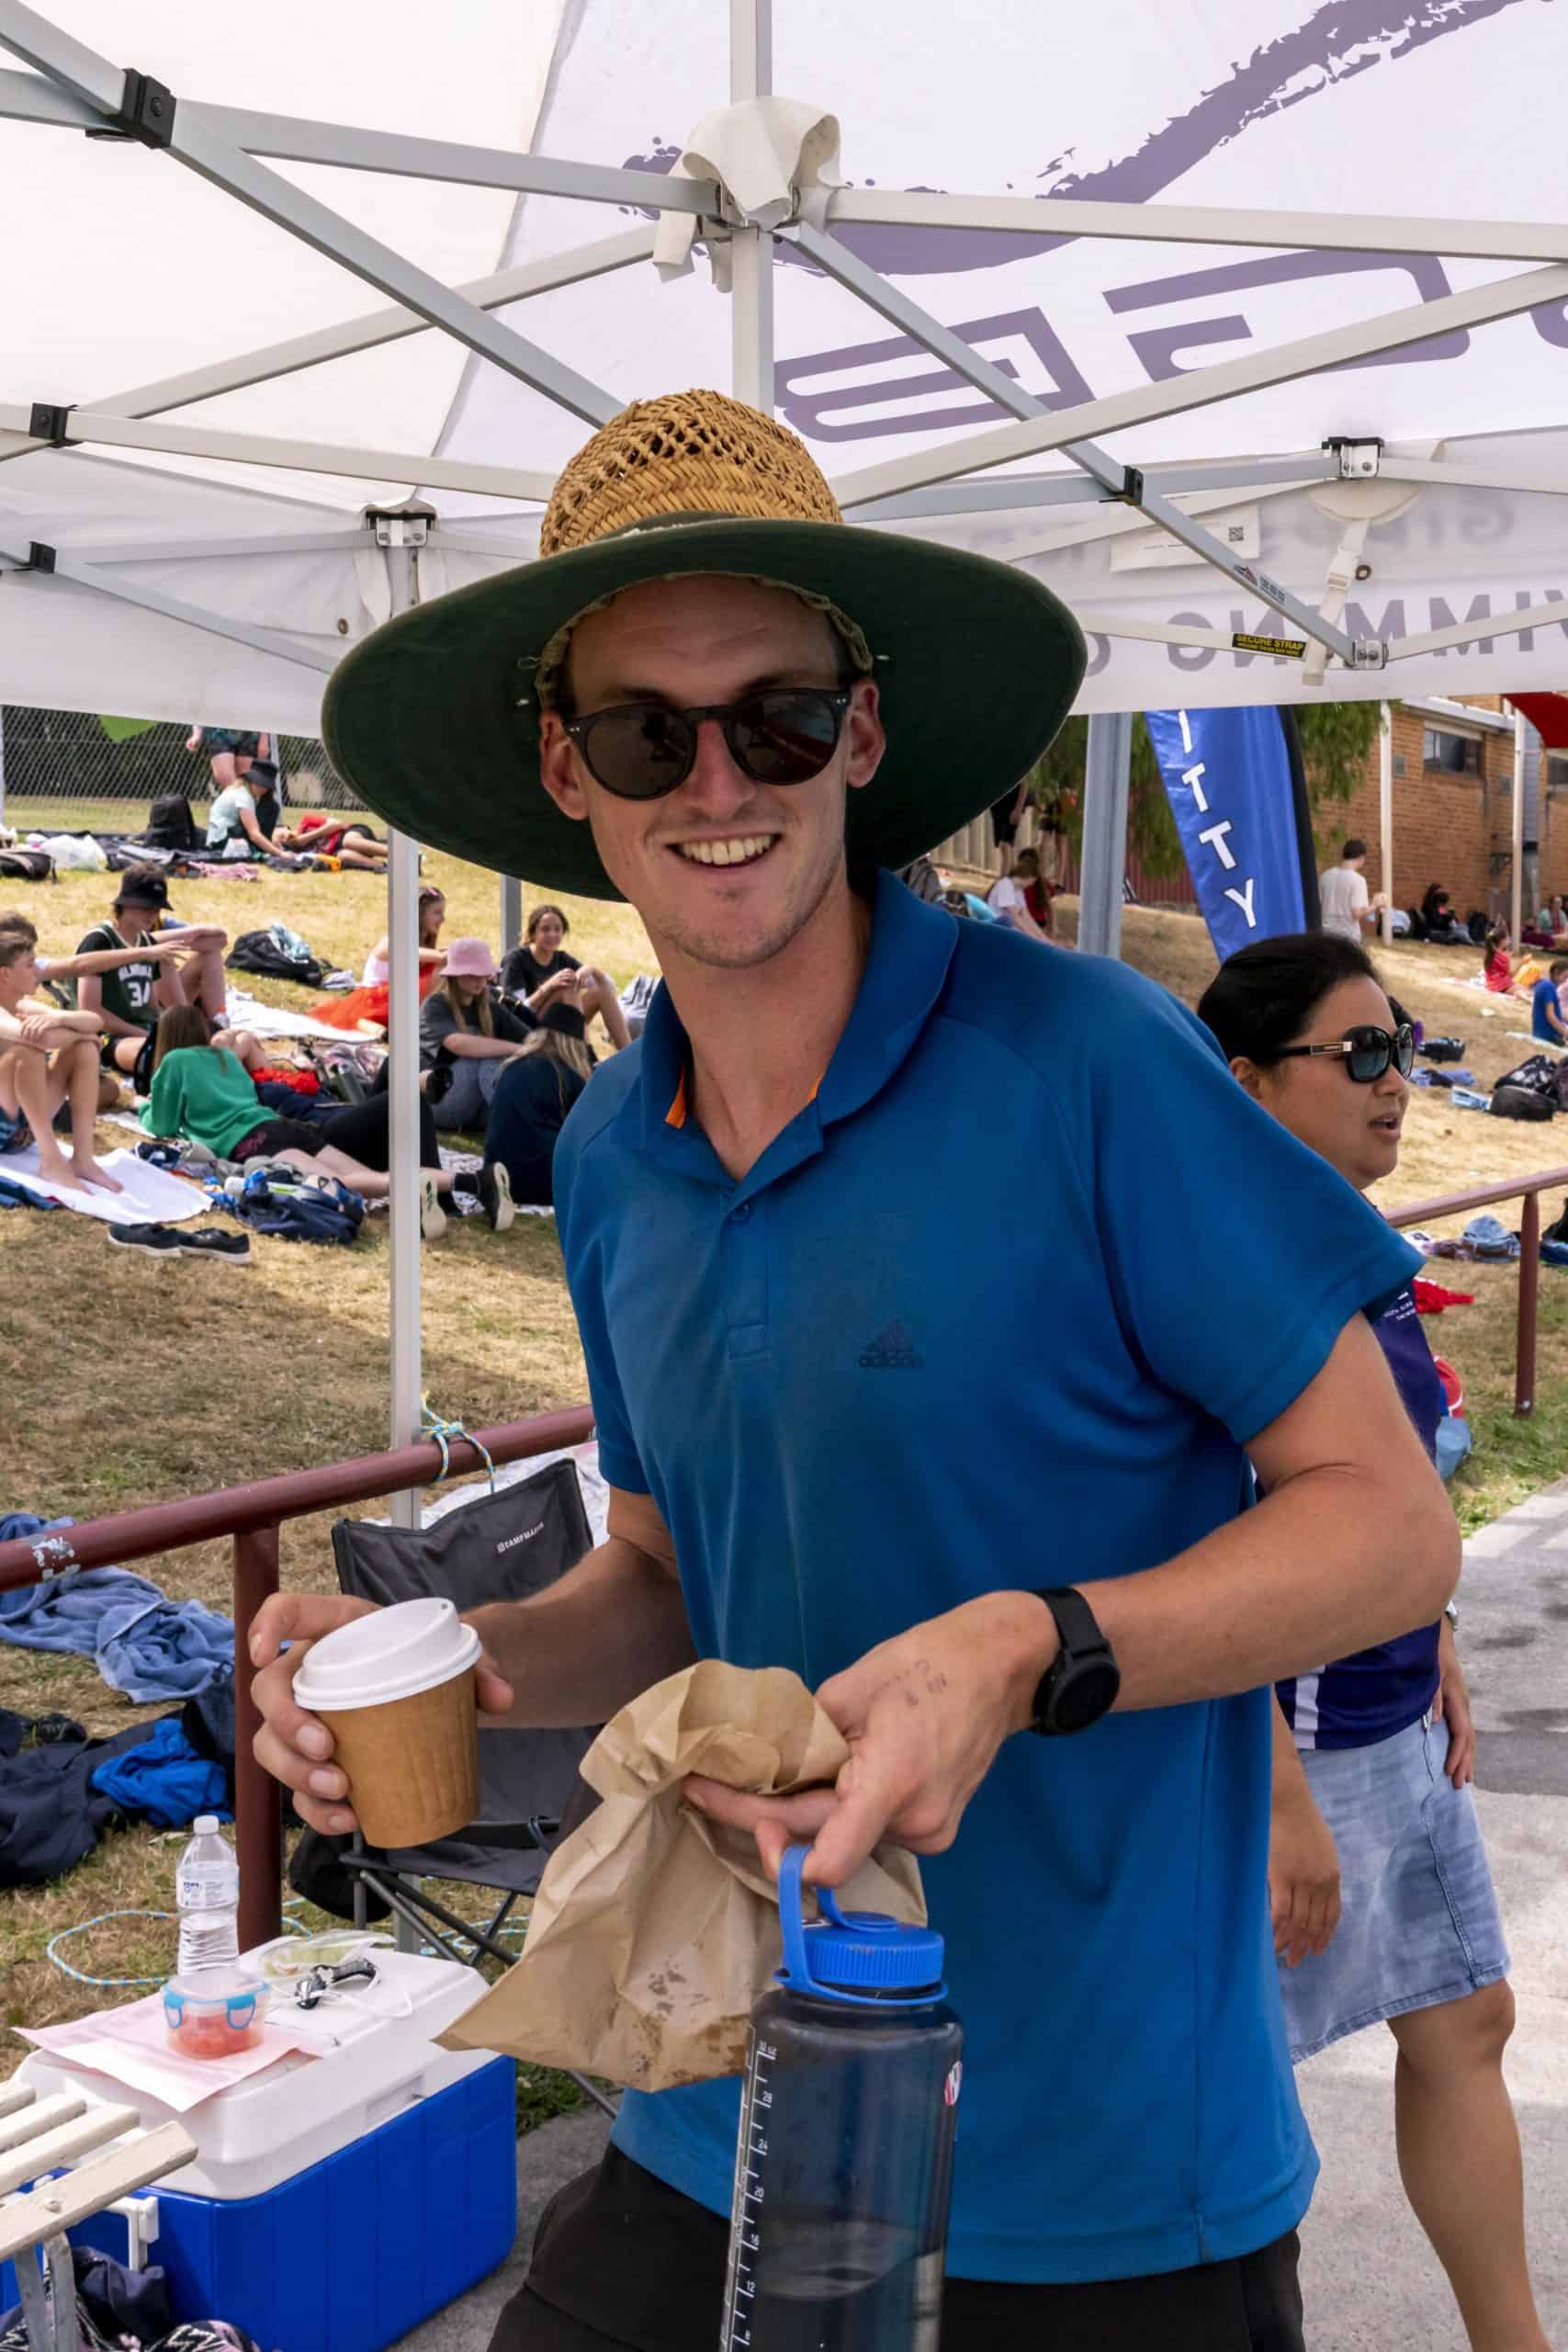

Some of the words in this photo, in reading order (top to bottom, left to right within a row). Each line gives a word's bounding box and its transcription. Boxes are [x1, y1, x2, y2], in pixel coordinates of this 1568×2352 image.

[1274, 638, 1303, 650] STRAP
[762, 2091, 773, 2104] 28
[758, 2138, 768, 2150] 24
[754, 2187, 764, 2199] 20
[750, 2233, 760, 2246] 16
[746, 2280, 755, 2293] 12
